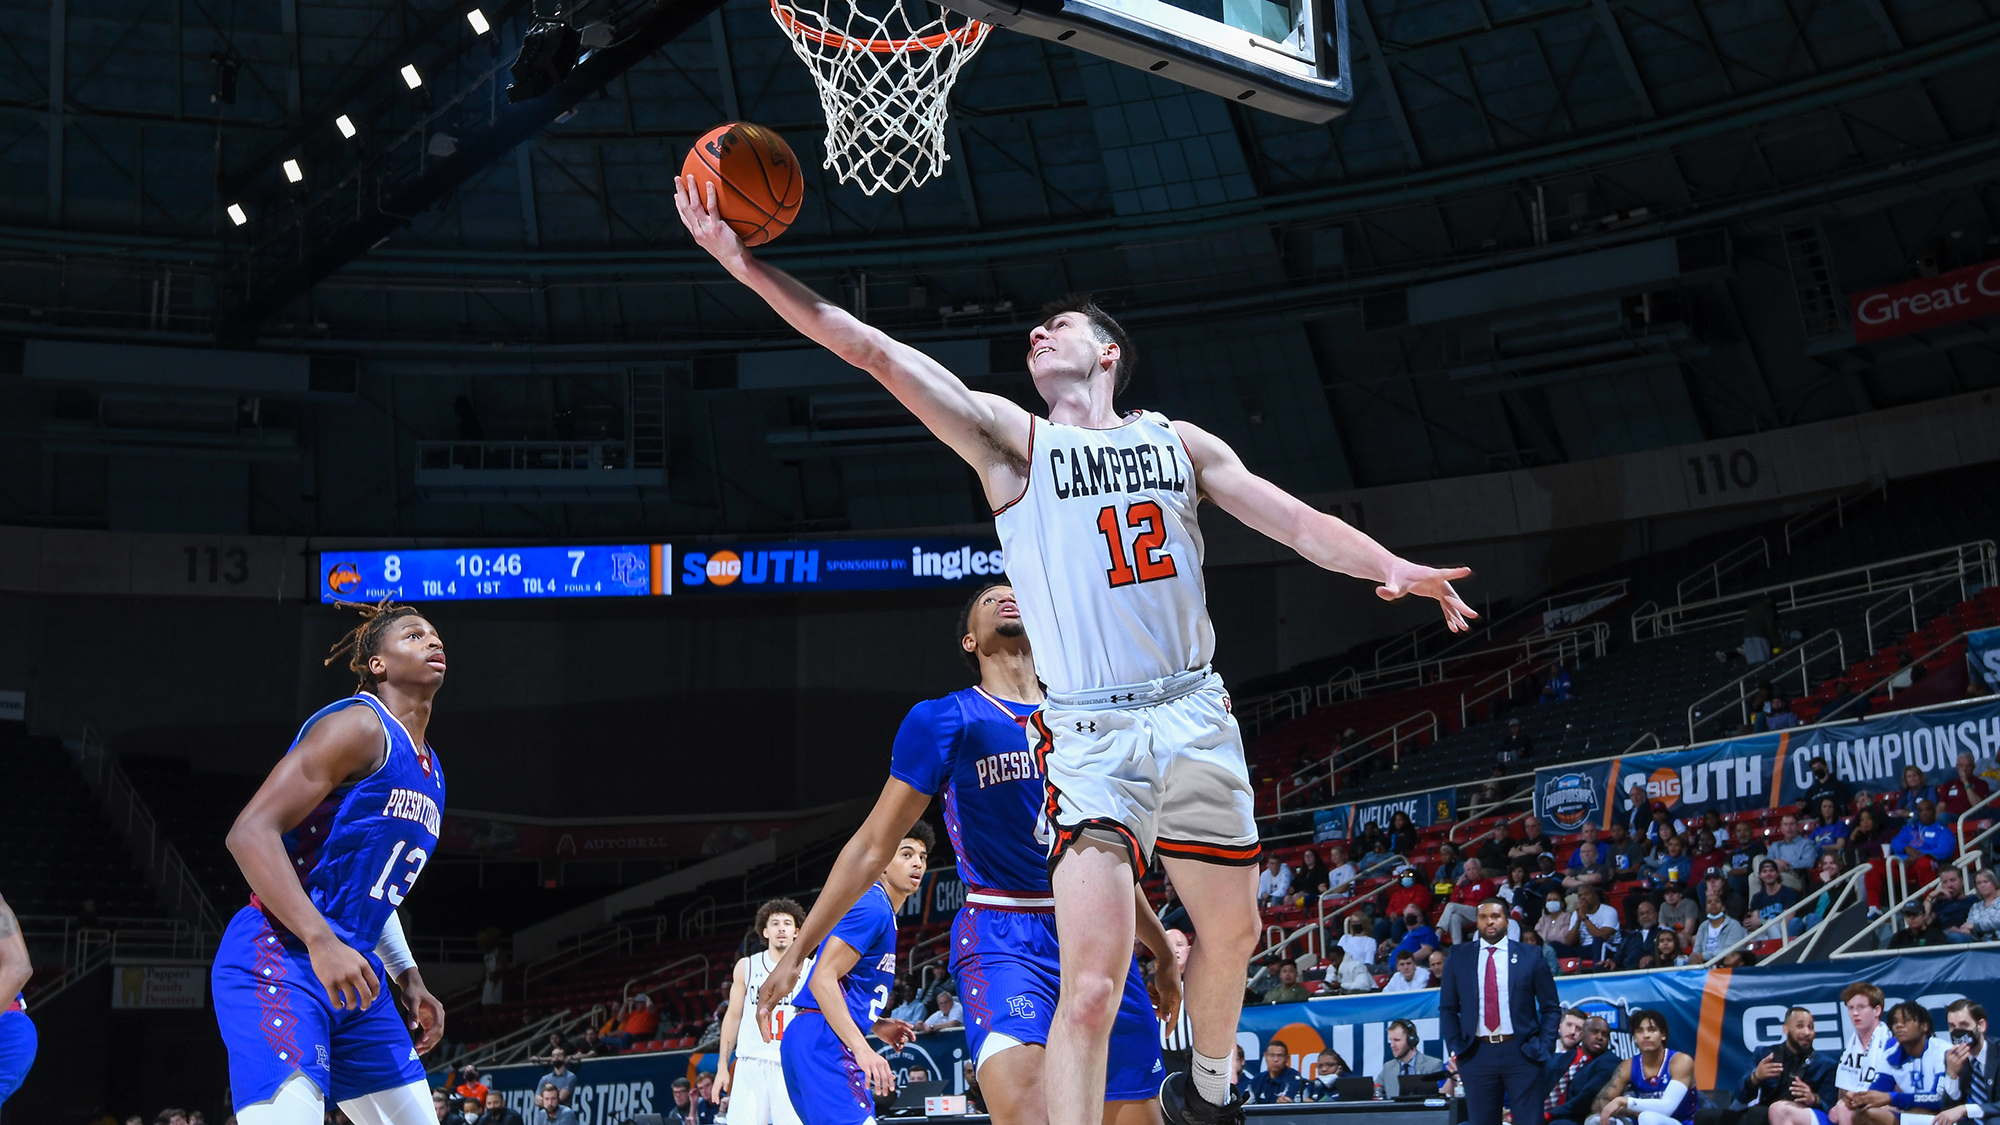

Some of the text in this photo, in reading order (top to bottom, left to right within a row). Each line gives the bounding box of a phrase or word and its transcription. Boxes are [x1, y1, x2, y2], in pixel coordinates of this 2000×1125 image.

[1857, 280, 1971, 325] Great
[1050, 443, 1185, 500] CAMPBELL
[1688, 448, 1759, 495] 110
[1096, 499, 1178, 588] 12
[184, 546, 249, 584] 113
[384, 555, 402, 582] 8
[455, 554, 522, 577] 10:46
[567, 550, 585, 578] 7
[826, 560, 889, 572] SPONSORED
[912, 545, 1005, 580] ingles
[423, 581, 456, 597] TOL 4
[476, 582, 501, 595] 1ST
[523, 578, 556, 594] TOL 4
[564, 582, 602, 593] FOULS 4
[1646, 778, 1681, 798] BIG
[583, 837, 668, 850] AUTOBELL
[369, 839, 428, 907] 13
[868, 984, 889, 1023] 2
[596, 1081, 655, 1125] TIRES
